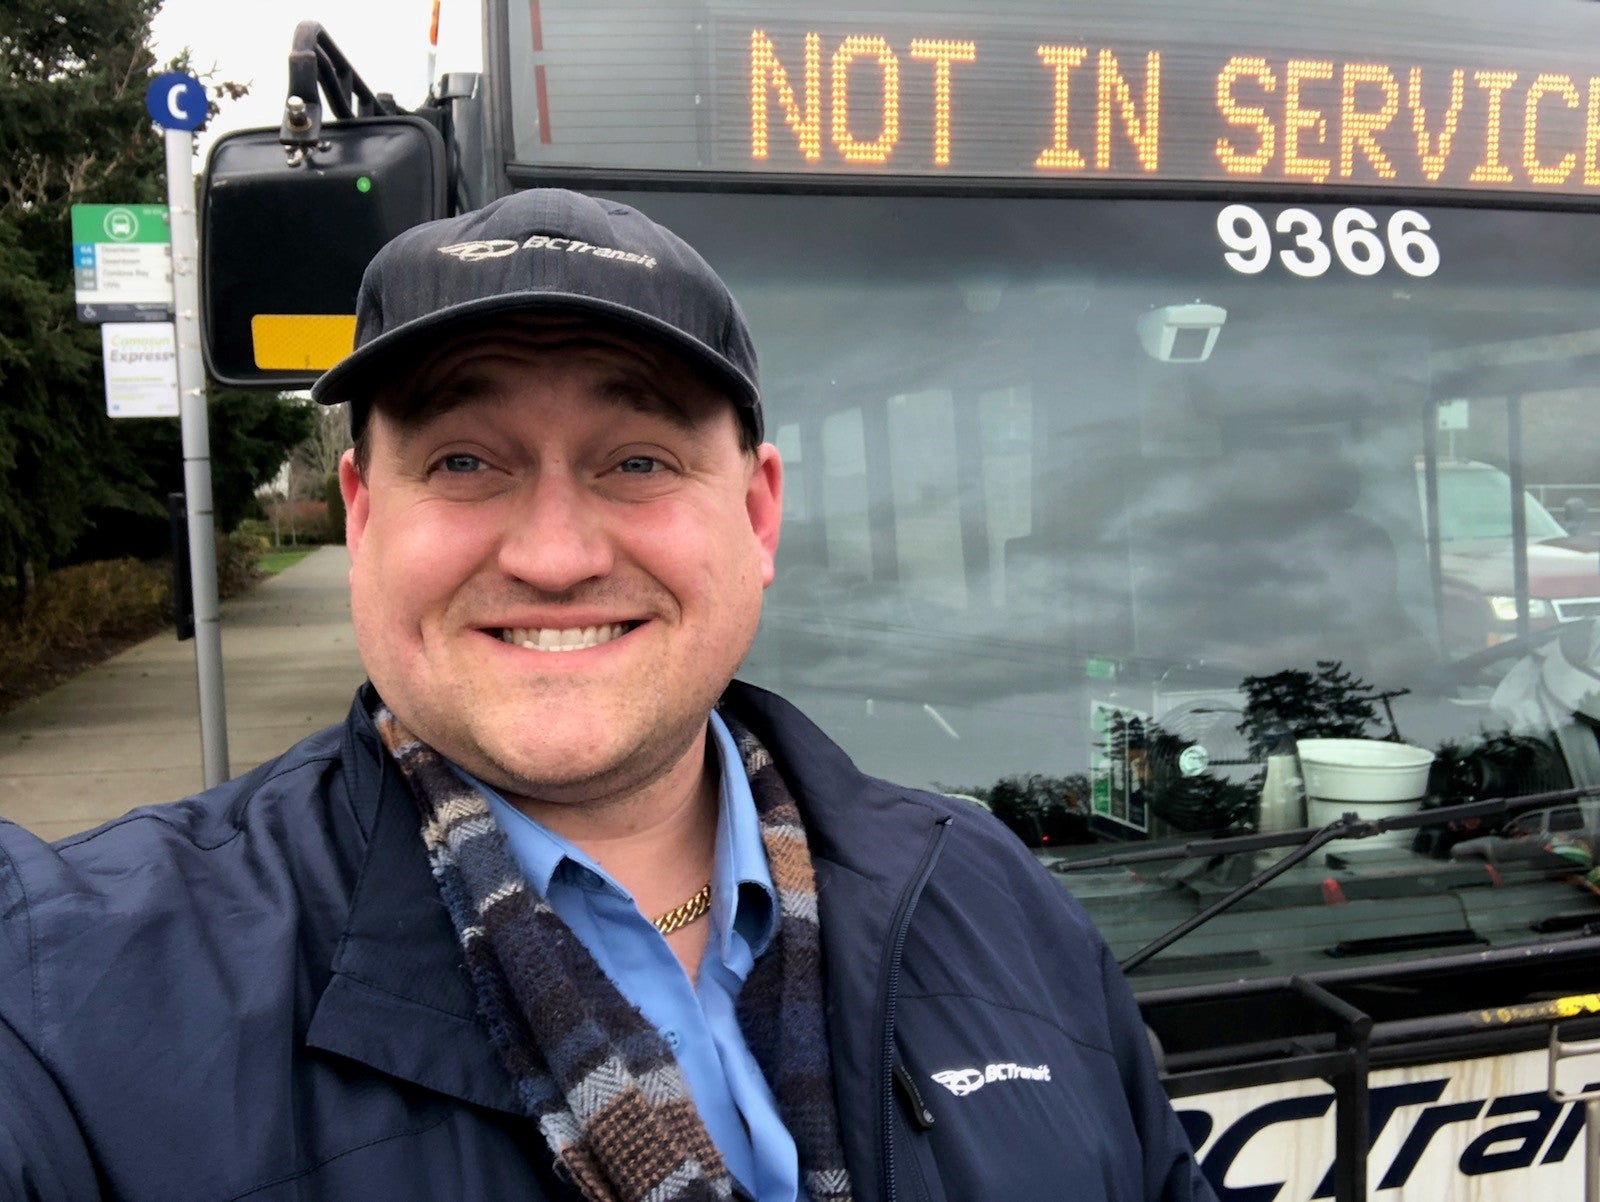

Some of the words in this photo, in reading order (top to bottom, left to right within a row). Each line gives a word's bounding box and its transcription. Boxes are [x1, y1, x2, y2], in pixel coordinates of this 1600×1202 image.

[166, 83, 189, 120] C
[750, 29, 976, 166] NOT
[1034, 45, 1161, 172] IN
[1216, 204, 1441, 279] 9366
[110, 348, 170, 365] Express
